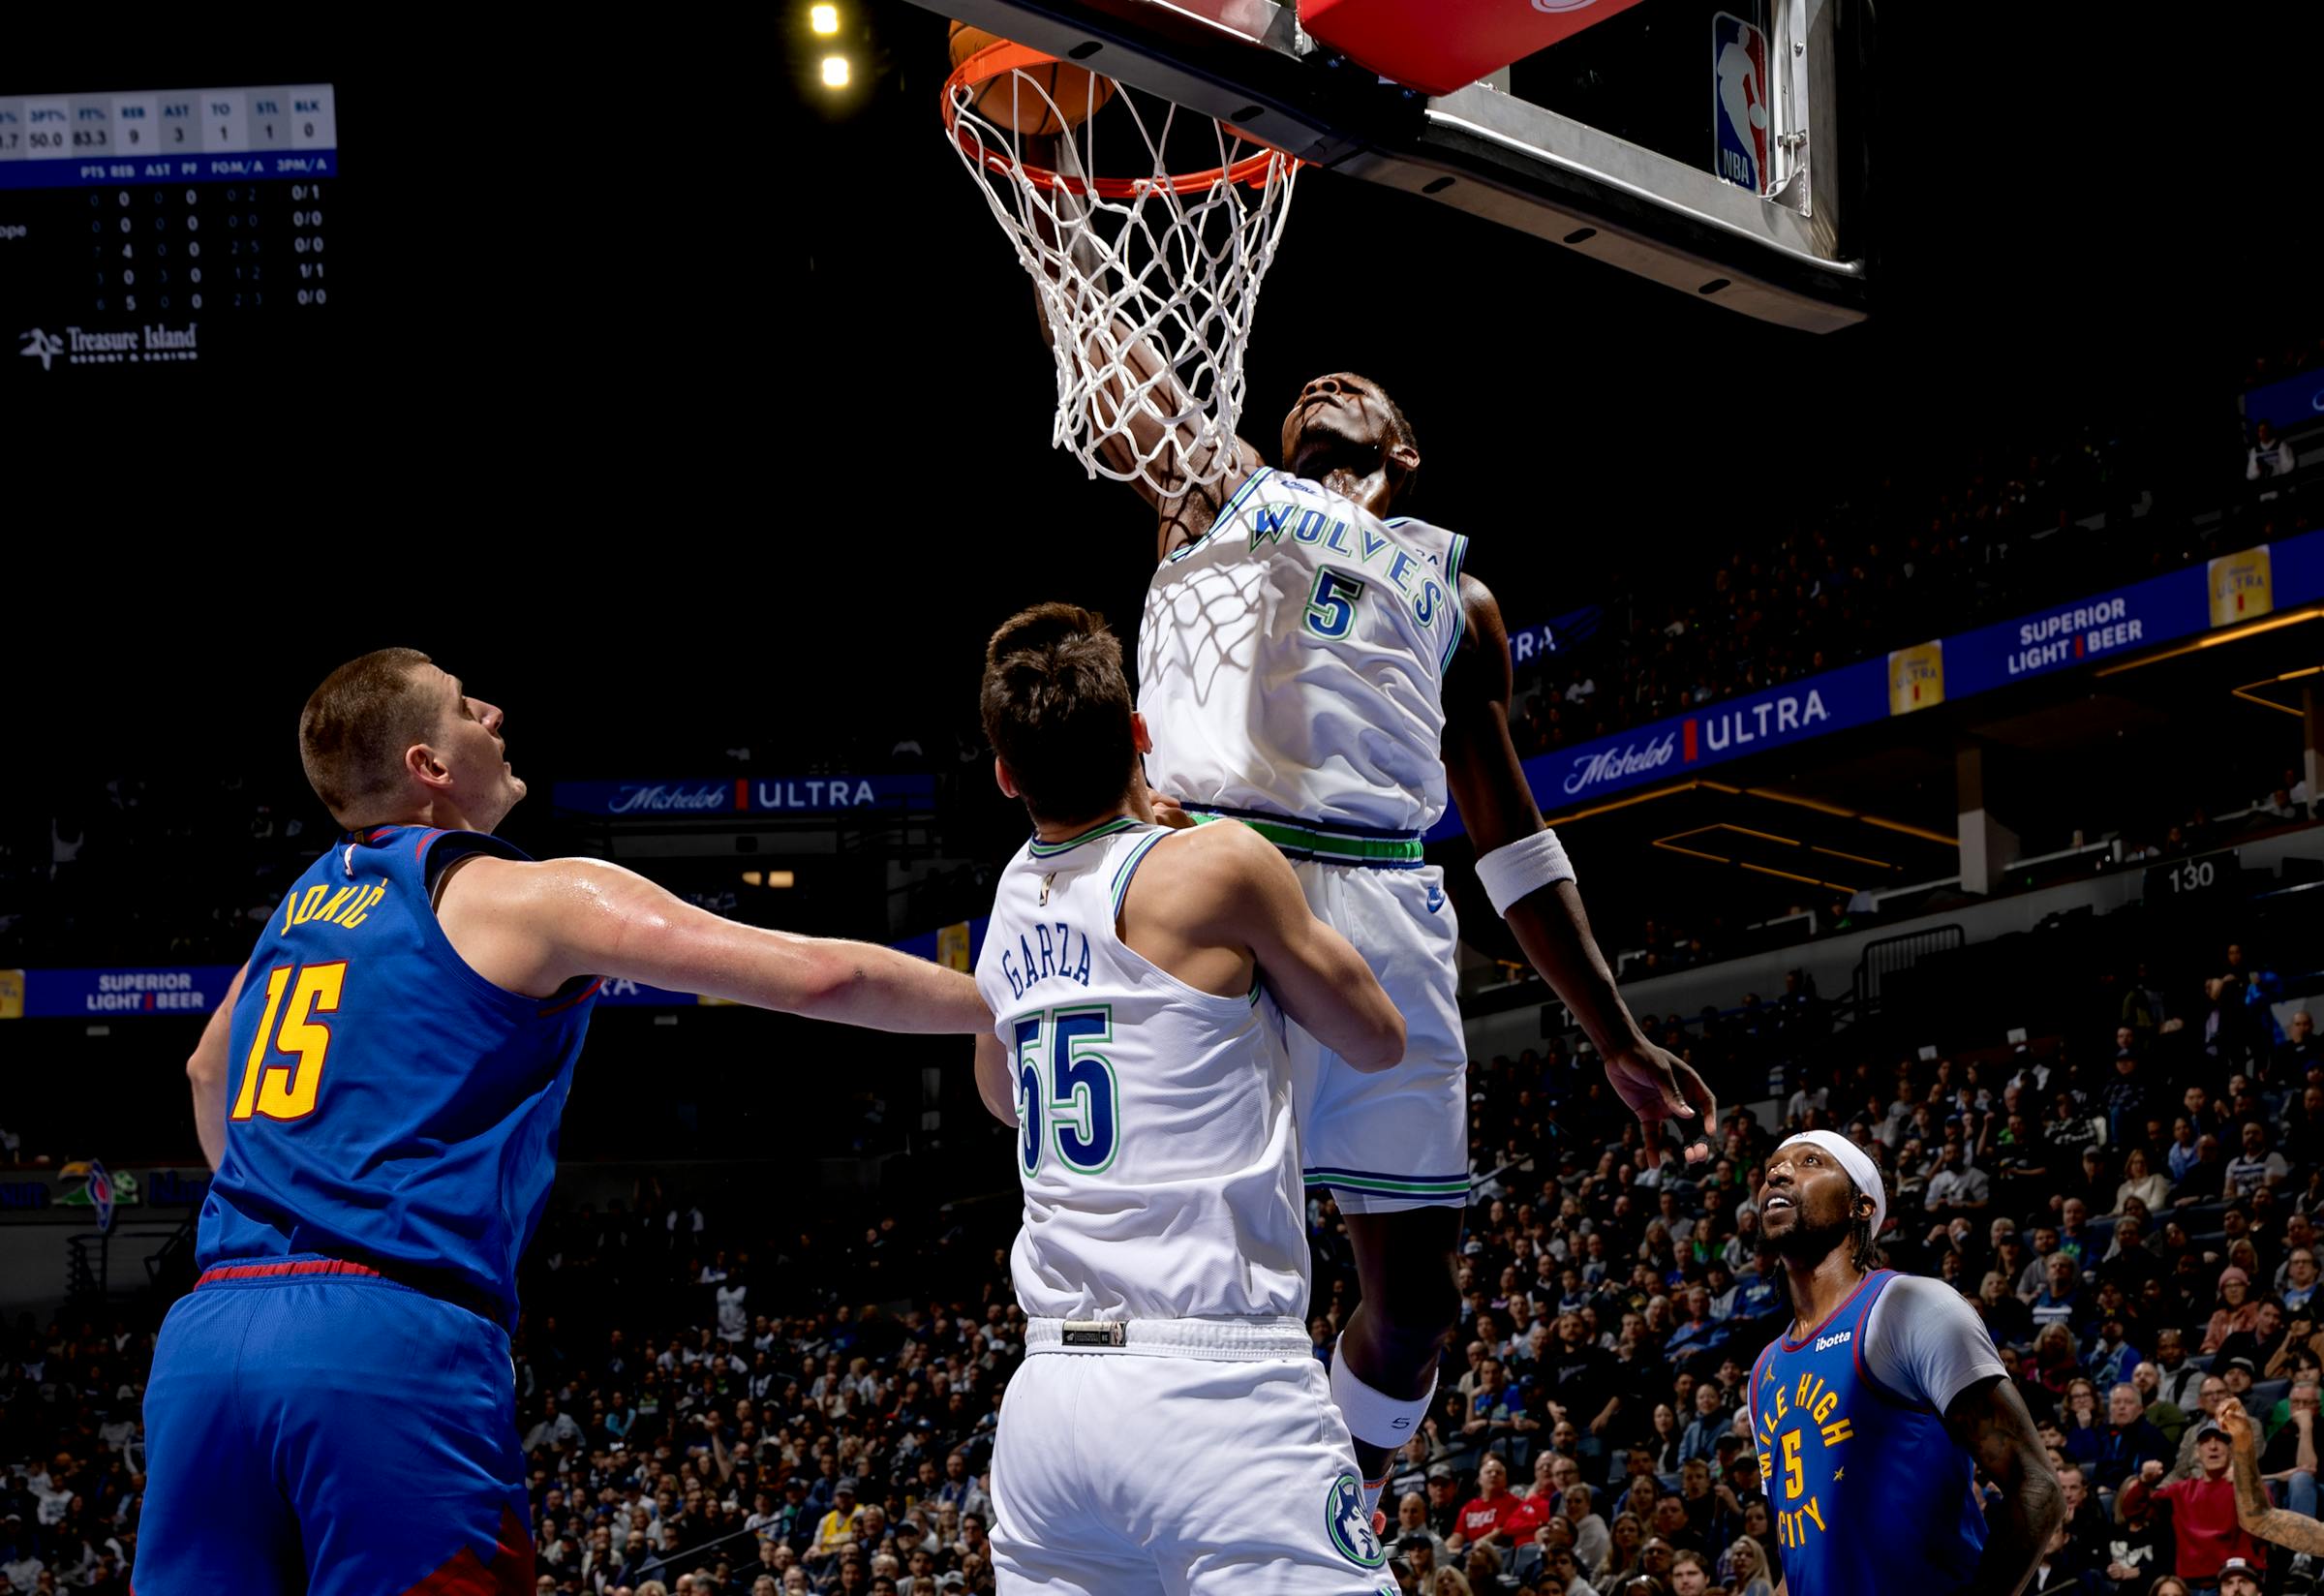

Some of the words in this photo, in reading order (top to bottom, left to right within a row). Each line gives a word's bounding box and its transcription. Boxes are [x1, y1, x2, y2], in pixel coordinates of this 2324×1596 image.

[121, 106, 145, 119] REB
[164, 105, 190, 117] AST
[210, 103, 231, 115] TO
[256, 101, 279, 114] STL
[293, 100, 321, 112] BLK
[29, 132, 63, 148] 50.0
[73, 129, 107, 145] 83.3
[129, 129, 139, 143] 9
[174, 127, 184, 142] 3
[221, 126, 229, 140] 1
[265, 124, 273, 139] 1
[304, 122, 314, 138] 0
[80, 166, 106, 178] PTS
[109, 165, 136, 177] REB
[145, 163, 170, 176] AST
[1723, 148, 1750, 185] NBA
[118, 191, 131, 207] 0
[186, 189, 198, 205] 0
[119, 216, 133, 233] 0
[187, 214, 199, 232] 0
[188, 240, 200, 258] 0
[123, 267, 136, 286] 0
[190, 266, 201, 284] 0
[191, 292, 203, 310] 0
[65, 325, 139, 352] Treasure
[142, 322, 199, 350] Island
[1249, 504, 1444, 628] WOLVES
[1302, 564, 1365, 641] 5
[2020, 598, 2125, 646] SUPERIOR
[2007, 638, 2069, 675] LIGHT
[2087, 619, 2143, 654] BEER
[1564, 732, 1676, 795] Michelob
[1706, 690, 1827, 751] ULTRA
[609, 784, 727, 813] Michelob
[759, 781, 875, 808] ULTRA
[2169, 861, 2215, 893] 130
[280, 877, 388, 937] JOKIĆ
[1001, 922, 1091, 1000] GARZA
[99, 973, 192, 992] SUPERIOR
[86, 994, 142, 1011] LIGHT
[156, 992, 204, 1009] BEER
[229, 960, 349, 1122] 15
[1011, 1003, 1120, 1179] 55
[1815, 1330, 1851, 1352] ibotta
[1391, 1417, 1411, 1429] 5
[1758, 1385, 1789, 1480] MILE
[1794, 1372, 1854, 1448] HIGH
[1780, 1427, 1804, 1500] 5
[1778, 1495, 1827, 1550] CITY
